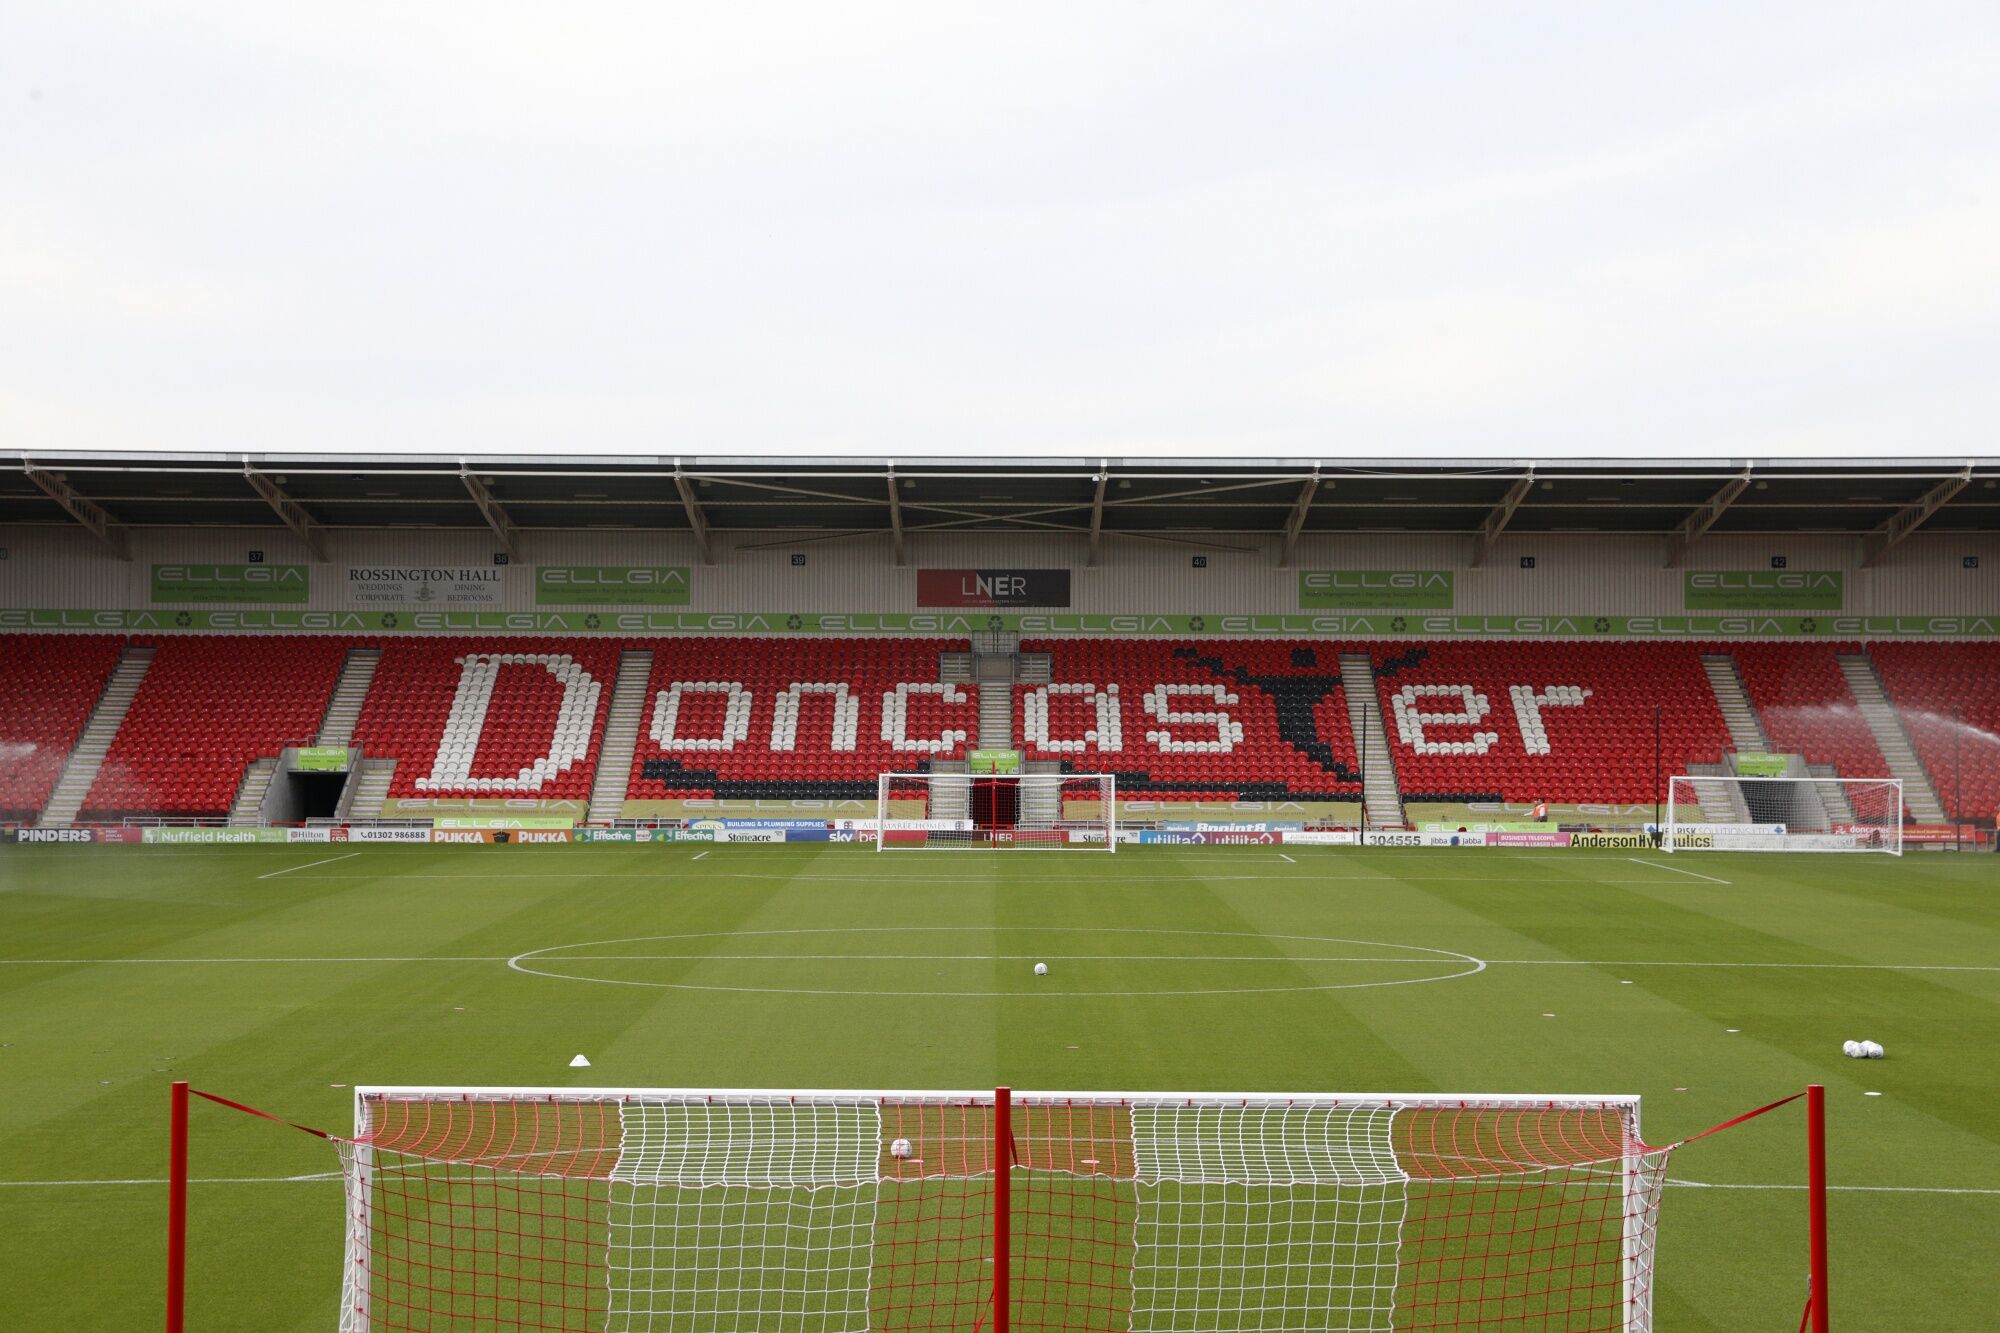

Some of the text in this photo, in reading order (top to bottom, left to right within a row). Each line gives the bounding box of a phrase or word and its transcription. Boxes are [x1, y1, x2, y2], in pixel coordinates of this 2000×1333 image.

[250, 552, 262, 561] 37
[495, 554, 507, 563] 38
[793, 555, 805, 565] 39
[1193, 558, 1206, 566] 40
[1773, 557, 1785, 567] 42
[1522, 558, 1534, 567] 41
[157, 567, 304, 582] ELLGIA
[349, 569, 500, 582] ROSSINGTON HALL
[541, 569, 685, 584] ELLGIA
[962, 573, 1027, 599] LNER
[1305, 574, 1448, 588] ELLGIA
[1690, 574, 1837, 588] ELLGIA
[357, 583, 403, 591] WEDDINGS
[454, 583, 485, 591] DINING
[355, 594, 406, 602] CORPORATE
[447, 594, 493, 602] BEDROOMS
[0, 611, 159, 627] ELLGIA
[209, 613, 365, 628] ELLGIA
[414, 613, 568, 629] ELLGIA
[617, 614, 770, 630] ELLGIA
[819, 615, 971, 631] ELLGIA
[1020, 616, 1172, 632] ELLGIA
[1221, 616, 1374, 633] ELLGIA
[1423, 617, 1577, 633] ELLGIA
[1627, 618, 1782, 633] ELLGIA
[1833, 618, 1995, 633] ELLGIA
[441, 819, 523, 828] ELLGIA
[18, 829, 92, 842] PINDERS
[161, 831, 214, 842] Nuffield
[217, 831, 256, 842] Health
[367, 831, 426, 839] 01302 986888
[434, 831, 484, 843] PUKKA
[518, 831, 567, 843] PUKKA
[593, 831, 631, 840] Effective
[675, 831, 714, 840] Effective
[728, 833, 771, 842] Stoneacre
[829, 831, 879, 842] sky be
[1083, 834, 1126, 842] Stonere
[1147, 834, 1191, 844] utilita
[1215, 834, 1259, 844] utilita
[1369, 835, 1421, 845] 304555
[1571, 834, 1637, 848] Anderson
